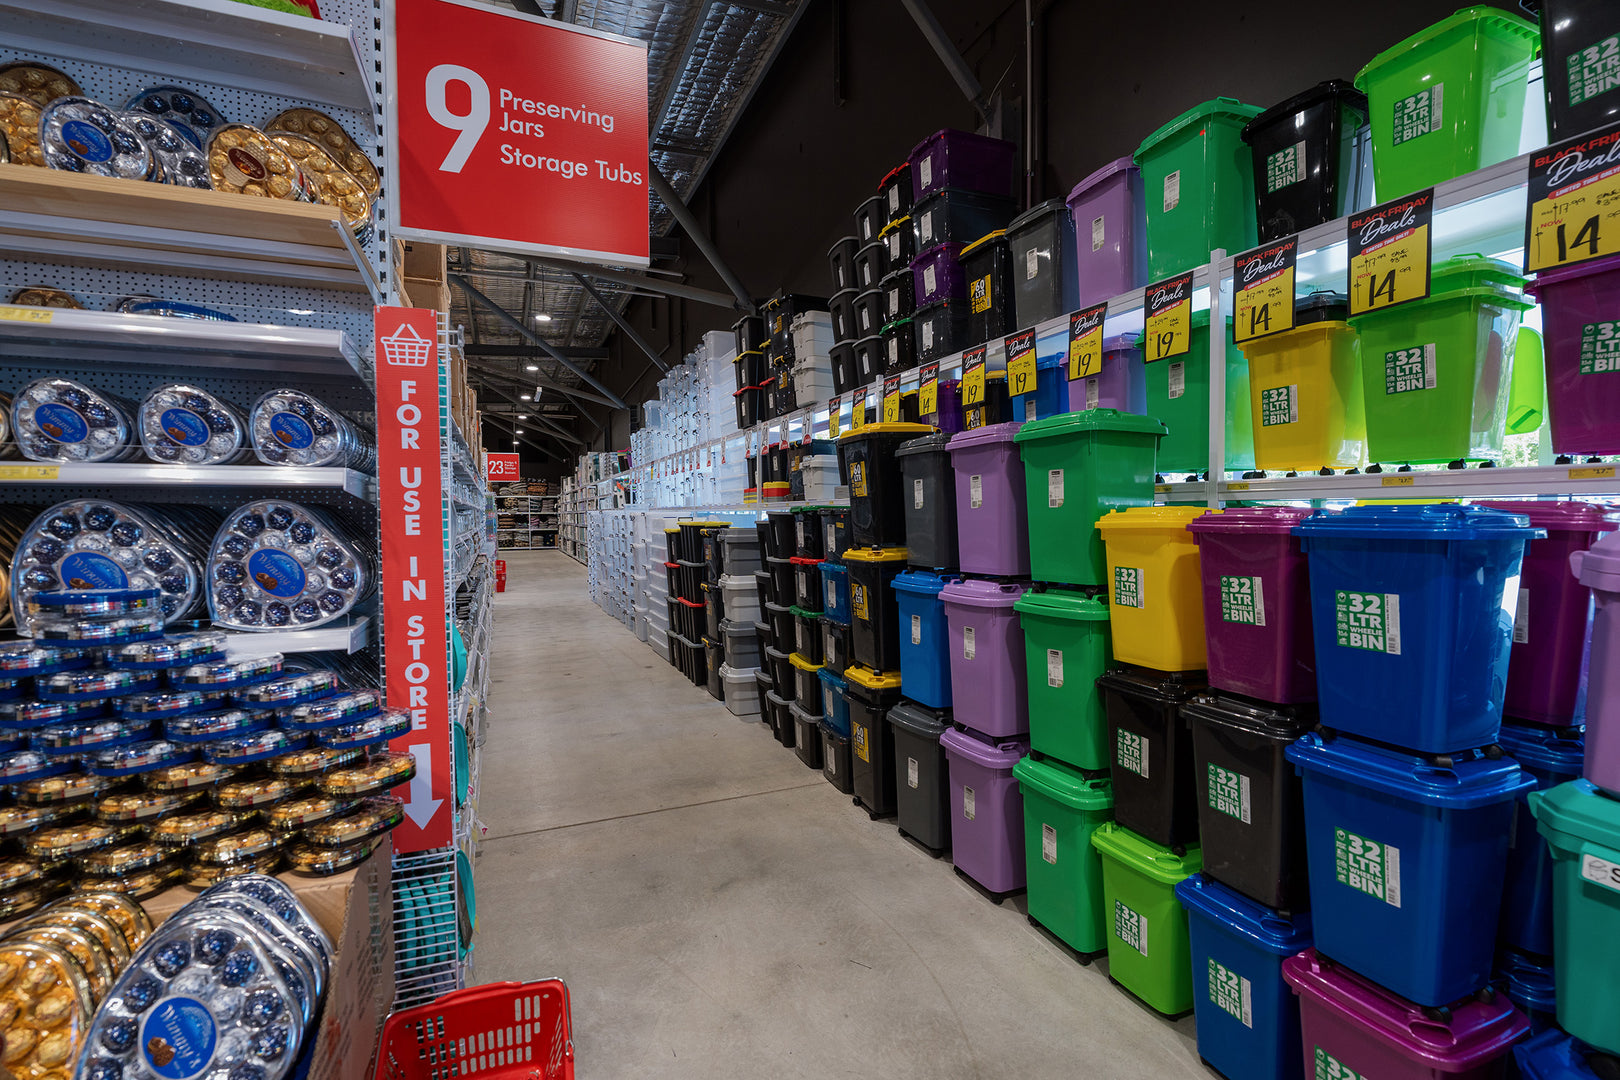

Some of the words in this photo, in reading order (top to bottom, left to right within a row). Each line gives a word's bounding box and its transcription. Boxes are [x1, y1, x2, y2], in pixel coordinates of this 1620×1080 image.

[1583, 37, 1619, 67] 32
[499, 88, 614, 133] Preserving
[1405, 91, 1429, 113] 32
[425, 64, 490, 173] 9
[499, 112, 545, 138] Jars
[1404, 107, 1429, 125] LTR
[1403, 122, 1430, 141] BIN
[1275, 148, 1294, 166] 32
[1534, 142, 1587, 168] BLACK
[1546, 138, 1620, 187] Deal
[500, 144, 588, 179] Storage
[595, 160, 642, 185] Tubs
[1275, 161, 1295, 176] LTR
[1275, 175, 1296, 190] BIN
[1352, 212, 1387, 230] BLACK
[1388, 196, 1429, 217] FRIDAY
[1360, 206, 1416, 246] Deals
[1541, 218, 1563, 228] NOW
[1236, 252, 1263, 268] BLACK
[1264, 242, 1295, 258] FRIDAY
[1243, 250, 1285, 282] Deals
[976, 280, 984, 292] 60
[1167, 276, 1192, 290] FRIDAY
[976, 290, 985, 298] LTR
[1151, 283, 1184, 310] Deals
[1074, 312, 1099, 335] Deals
[1009, 336, 1031, 356] Deals
[1157, 332, 1174, 358] 19
[1596, 340, 1620, 353] LT
[1077, 353, 1092, 376] 19
[1396, 348, 1422, 366] 32
[1594, 358, 1620, 372] BI
[1396, 362, 1422, 376] LTR
[1015, 372, 1027, 393] 19
[1396, 377, 1424, 392] BIN
[967, 384, 978, 404] 19
[1270, 387, 1288, 402] 32
[396, 380, 422, 450] FOR
[1270, 400, 1288, 412] LTR
[971, 410, 980, 421] 60
[1270, 413, 1289, 424] BIN
[489, 460, 504, 475] 23
[854, 464, 860, 474] 60
[400, 467, 421, 536] USE
[403, 556, 426, 601] IN
[1121, 568, 1136, 582] 32
[1121, 582, 1136, 592] LTR
[1229, 577, 1251, 594] 32
[1121, 595, 1136, 607] BIN
[1230, 593, 1252, 606] LTR
[1349, 594, 1381, 614] 32
[1231, 610, 1254, 623] BIN
[1350, 613, 1382, 628] LTR
[1350, 626, 1382, 636] WHEELIE
[1350, 632, 1384, 650] BIN
[405, 615, 429, 730] STORE
[1124, 732, 1140, 748] 32
[1124, 745, 1140, 759] LTR
[1124, 757, 1140, 774] BIN
[1217, 768, 1238, 789] 32
[1217, 783, 1238, 800] LTR
[1218, 800, 1240, 818] BIN
[1348, 834, 1380, 863] 32
[1348, 852, 1382, 878] LTR
[1349, 872, 1383, 898] BIN
[1122, 906, 1138, 926] 32
[1122, 918, 1138, 936] LTR
[1122, 932, 1139, 950] BIN
[1217, 964, 1238, 991] 32
[1217, 980, 1239, 1001] LTR
[1218, 998, 1241, 1020] BIN
[1328, 1056, 1356, 1080] 32
